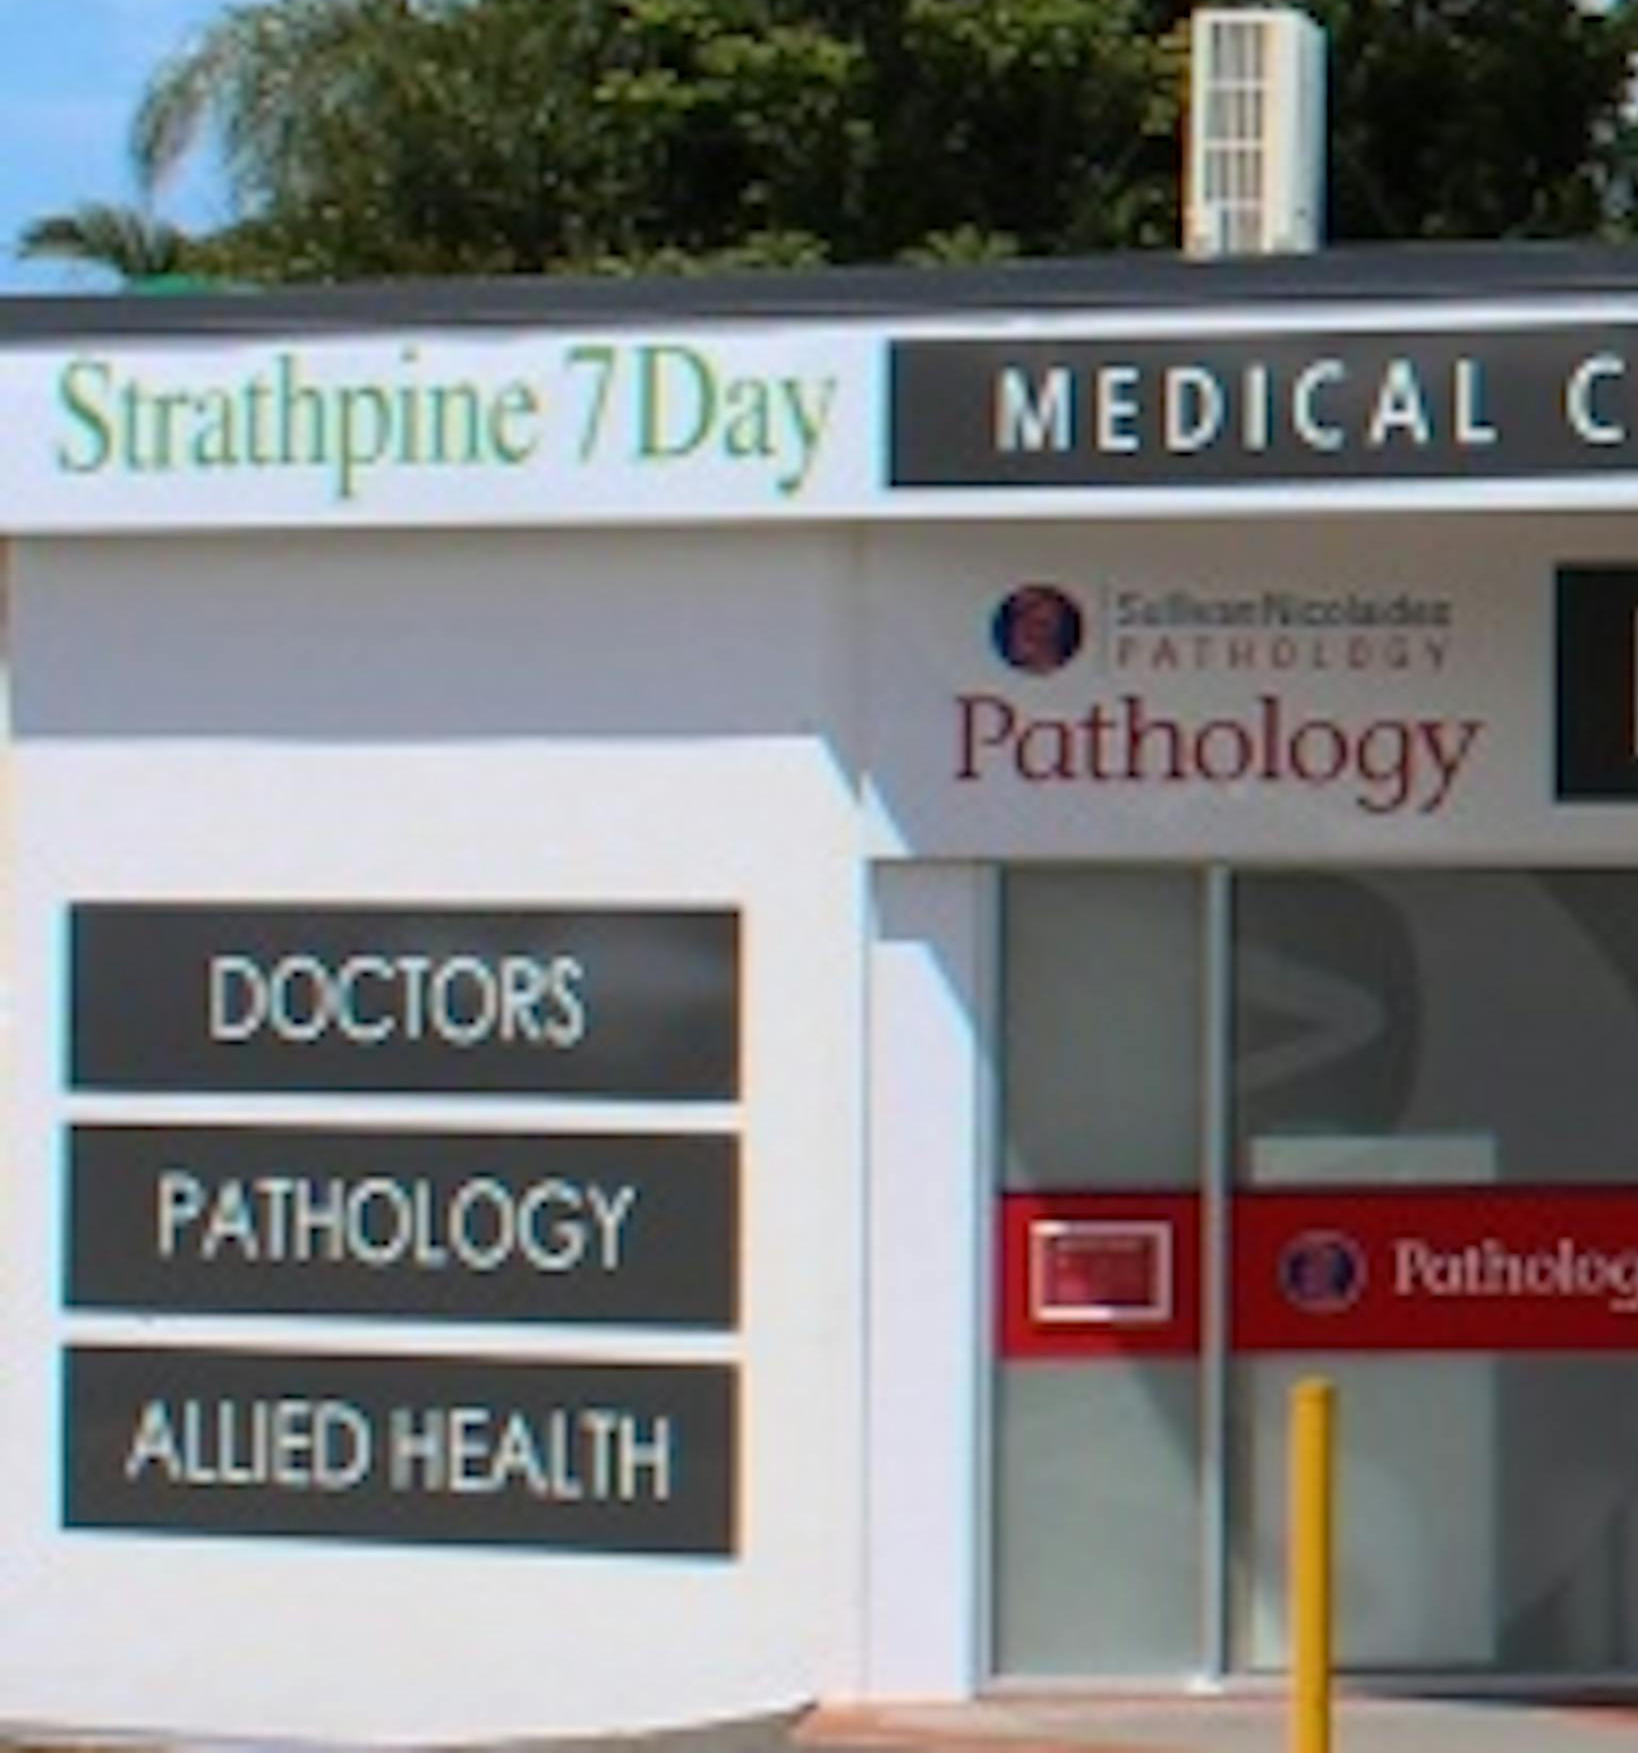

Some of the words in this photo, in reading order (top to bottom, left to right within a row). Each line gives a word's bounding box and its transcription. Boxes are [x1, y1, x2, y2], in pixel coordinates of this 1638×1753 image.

[54, 351, 542, 501] Strathpine
[993, 358, 1498, 455] MEDICAL
[1116, 636, 1452, 670] PATHOLOGY
[954, 696, 1485, 813] Pathology
[208, 956, 585, 1046] DOCTORS
[156, 1172, 637, 1272] PATHOLOGY
[127, 1398, 370, 1489] ALLIED
[390, 1408, 671, 1501] HEALTH
